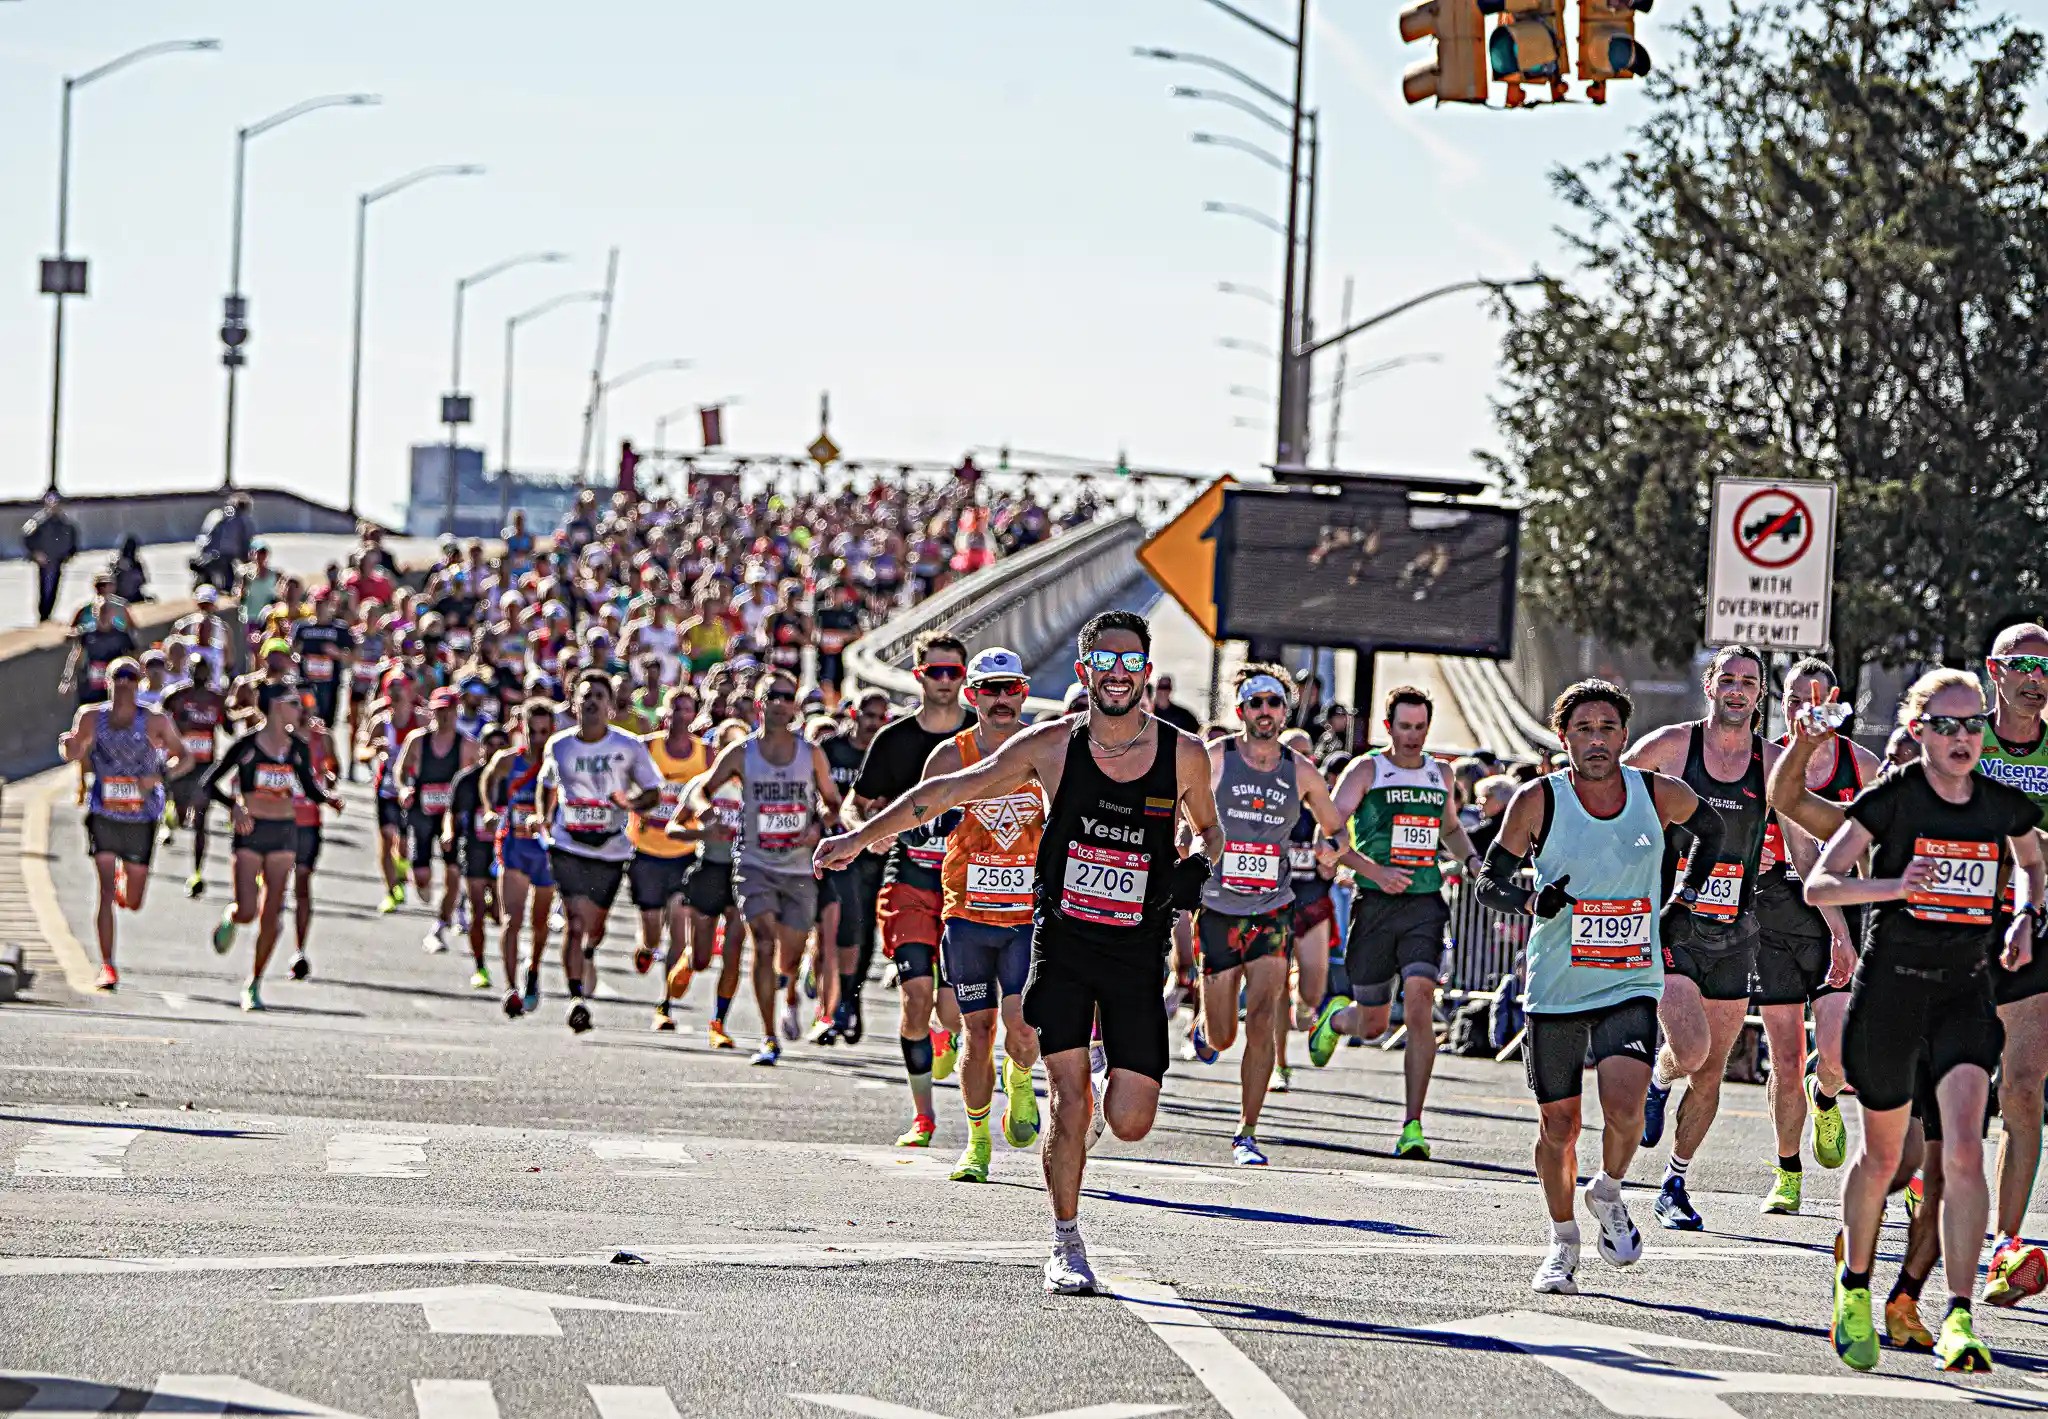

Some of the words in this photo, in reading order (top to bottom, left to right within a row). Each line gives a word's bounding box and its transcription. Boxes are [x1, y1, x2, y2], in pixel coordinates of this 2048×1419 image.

[1748, 576, 1792, 594] WITH
[1717, 598, 1819, 619] OVERWEIGHT
[1734, 624, 1799, 641] PERMIT
[1979, 758, 2048, 779] Vicenz
[1231, 784, 1262, 797] SOMA
[1266, 788, 1287, 805] FOX
[1386, 789, 1445, 806] IRELAND
[1105, 802, 1132, 815] BANDIT
[1227, 808, 1262, 822] RUNNING
[1080, 817, 1145, 845] Yesid
[1403, 828, 1432, 844] 1951
[1077, 845, 1094, 860] tcs
[1926, 841, 1946, 854] tcs
[976, 853, 990, 864] tcs
[1237, 855, 1267, 873] 839
[977, 867, 1025, 887] 2563
[1075, 863, 1135, 894] 2706
[1938, 860, 1985, 887] 940
[1113, 911, 1132, 920] 2024
[1583, 902, 1601, 913] tcs
[1580, 915, 1645, 939] 21997
